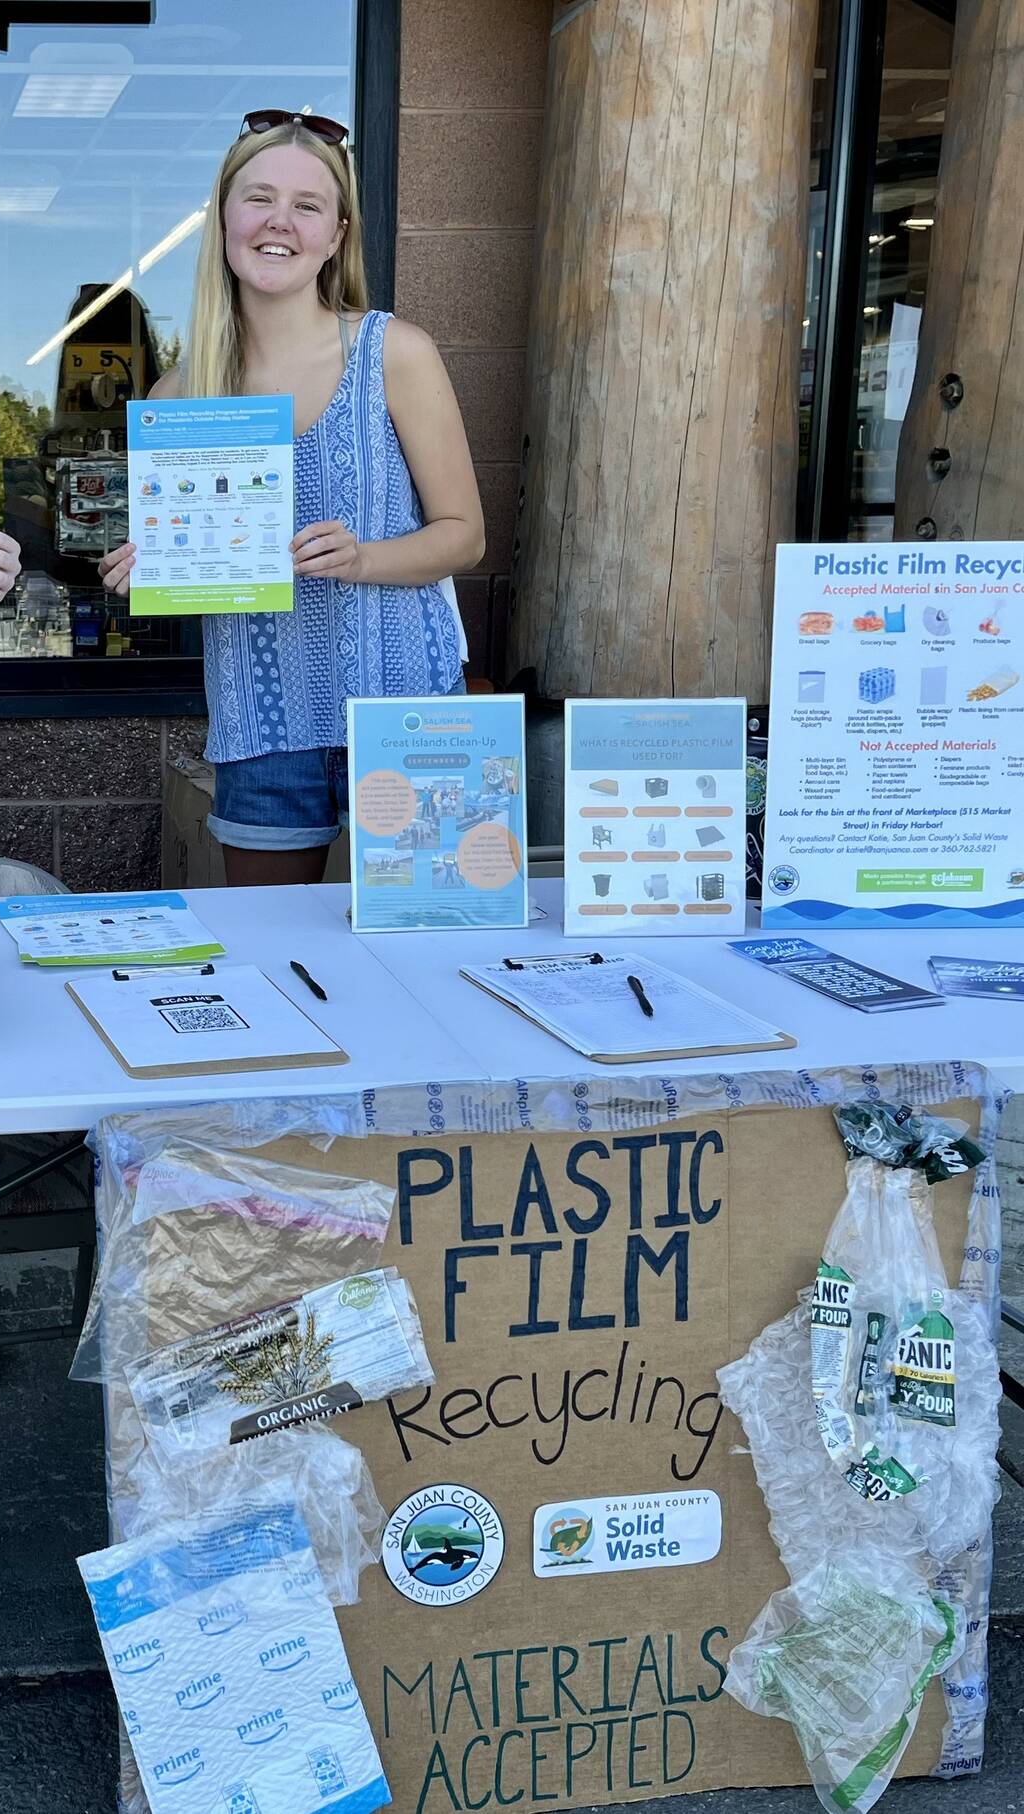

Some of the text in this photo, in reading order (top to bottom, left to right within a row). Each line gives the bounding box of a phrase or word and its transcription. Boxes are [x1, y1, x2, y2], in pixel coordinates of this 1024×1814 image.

[814, 553, 888, 574] Plastic
[898, 552, 945, 574] Film
[823, 583, 876, 597] Accepted
[954, 583, 976, 593] San
[980, 583, 1008, 594] Juan
[381, 737, 496, 749] Great Islands Clean-Up
[579, 738, 607, 748] WHAT
[620, 738, 667, 748] RECYCLED
[671, 738, 710, 748] PLASTIC
[712, 738, 734, 748] FILM
[632, 751, 684, 761] USED FOR?
[860, 739, 996, 753] Not Accepted Materials
[779, 808, 798, 816] Look
[801, 808, 812, 816] for
[815, 808, 828, 816] the
[872, 807, 892, 815] front
[894, 807, 904, 816] of
[905, 807, 958, 817] Marketplace
[959, 807, 979, 816] (515
[778, 834, 794, 844] Any
[868, 834, 889, 842] Katie,
[892, 833, 906, 841] San
[962, 832, 982, 840] Solid
[842, 821, 869, 829] Street)
[881, 821, 908, 830] Friday
[160, 994, 215, 1005] SCAN ME
[397, 1129, 724, 1245] PLASTIC
[444, 1230, 690, 1344] FILM
[819, 1308, 848, 1325] FOUR
[257, 1394, 329, 1429] ORGANIC
[385, 1340, 726, 1482] Recycling
[916, 1394, 954, 1415] FOUR
[605, 1496, 711, 1512] SAN JUAN COUNTY
[386, 1488, 501, 1550] SAN JUAN COUNTY
[606, 1513, 665, 1539] Solid
[606, 1537, 682, 1563] Waste
[392, 1561, 495, 1603] WASHINGTON
[197, 1598, 247, 1632] prime
[112, 1636, 162, 1667] prime
[258, 1634, 308, 1667] prime
[175, 1670, 223, 1705] prime
[383, 1625, 729, 1738] MATERIALS
[236, 1705, 285, 1741] prime
[152, 1746, 202, 1780] prime
[416, 1710, 696, 1814] ACCEPTED
